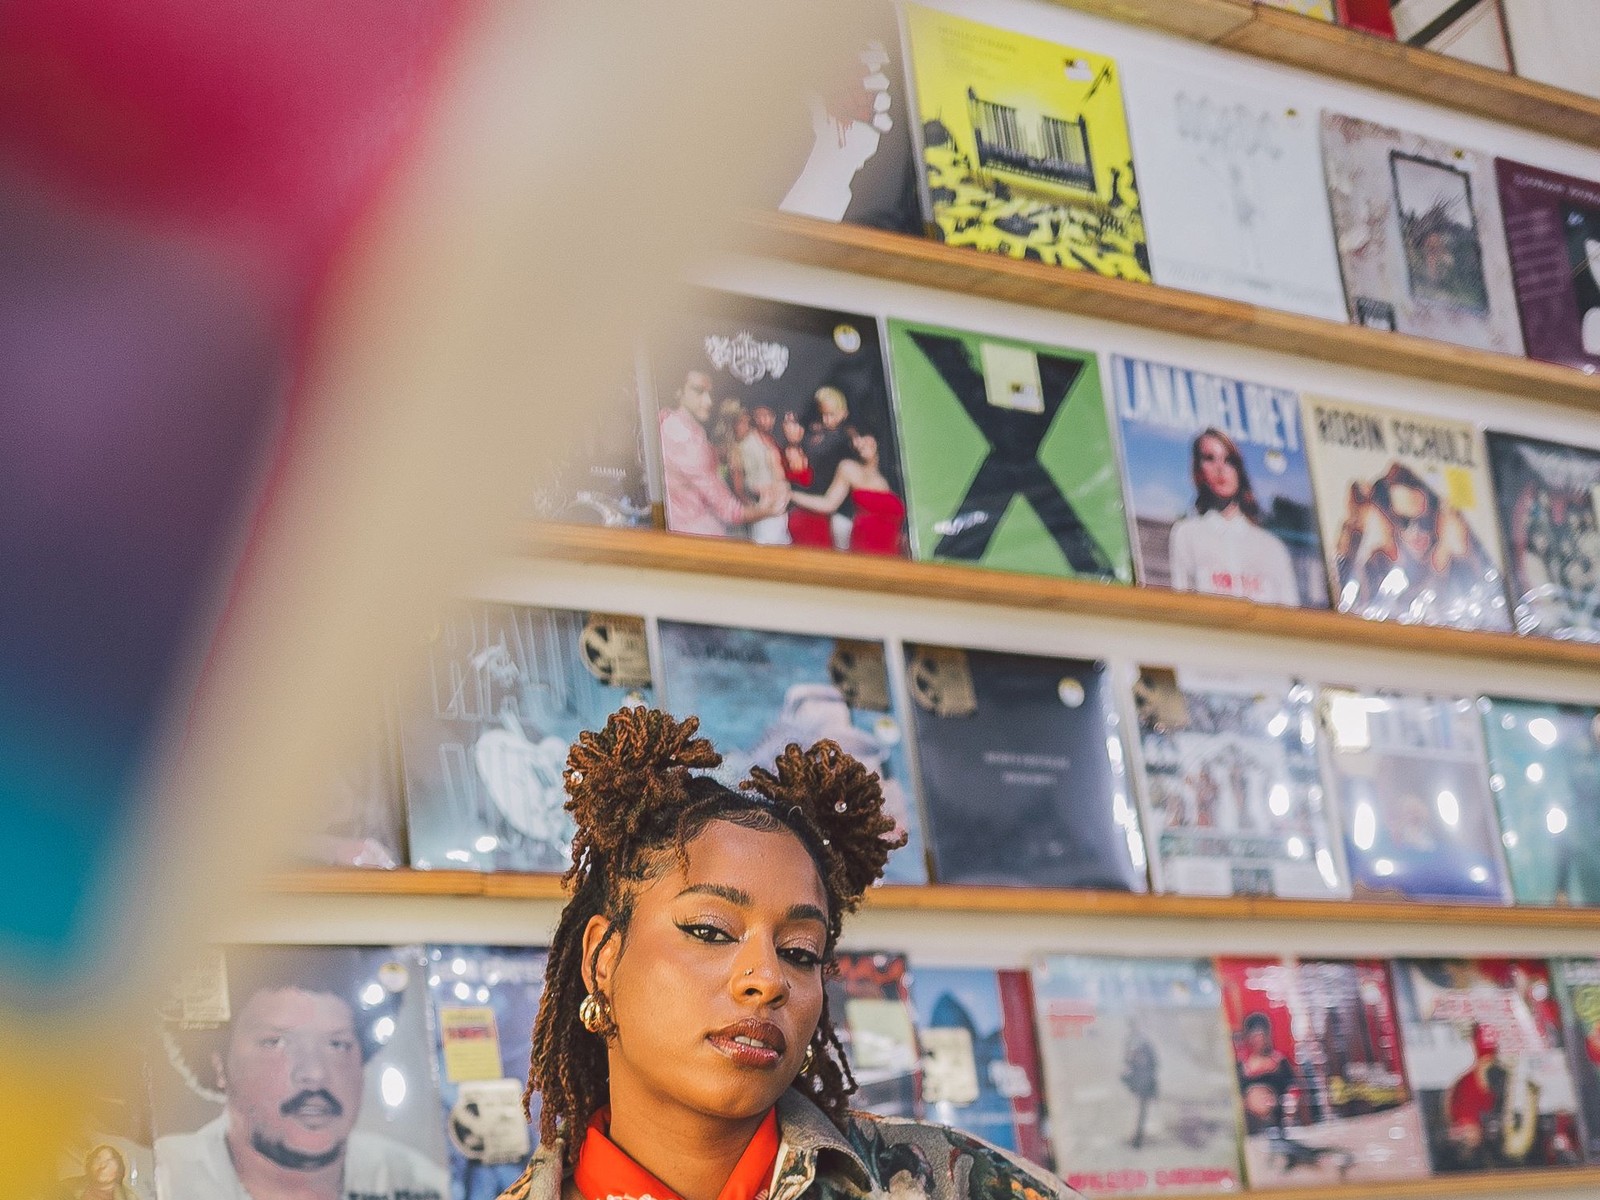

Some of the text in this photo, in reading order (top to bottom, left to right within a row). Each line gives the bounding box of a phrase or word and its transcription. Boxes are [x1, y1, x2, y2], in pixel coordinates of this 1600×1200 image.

[1111, 353, 1199, 432] LANA
[1246, 383, 1300, 452] REY
[1313, 406, 1476, 468] ROBIN SCHULZ
